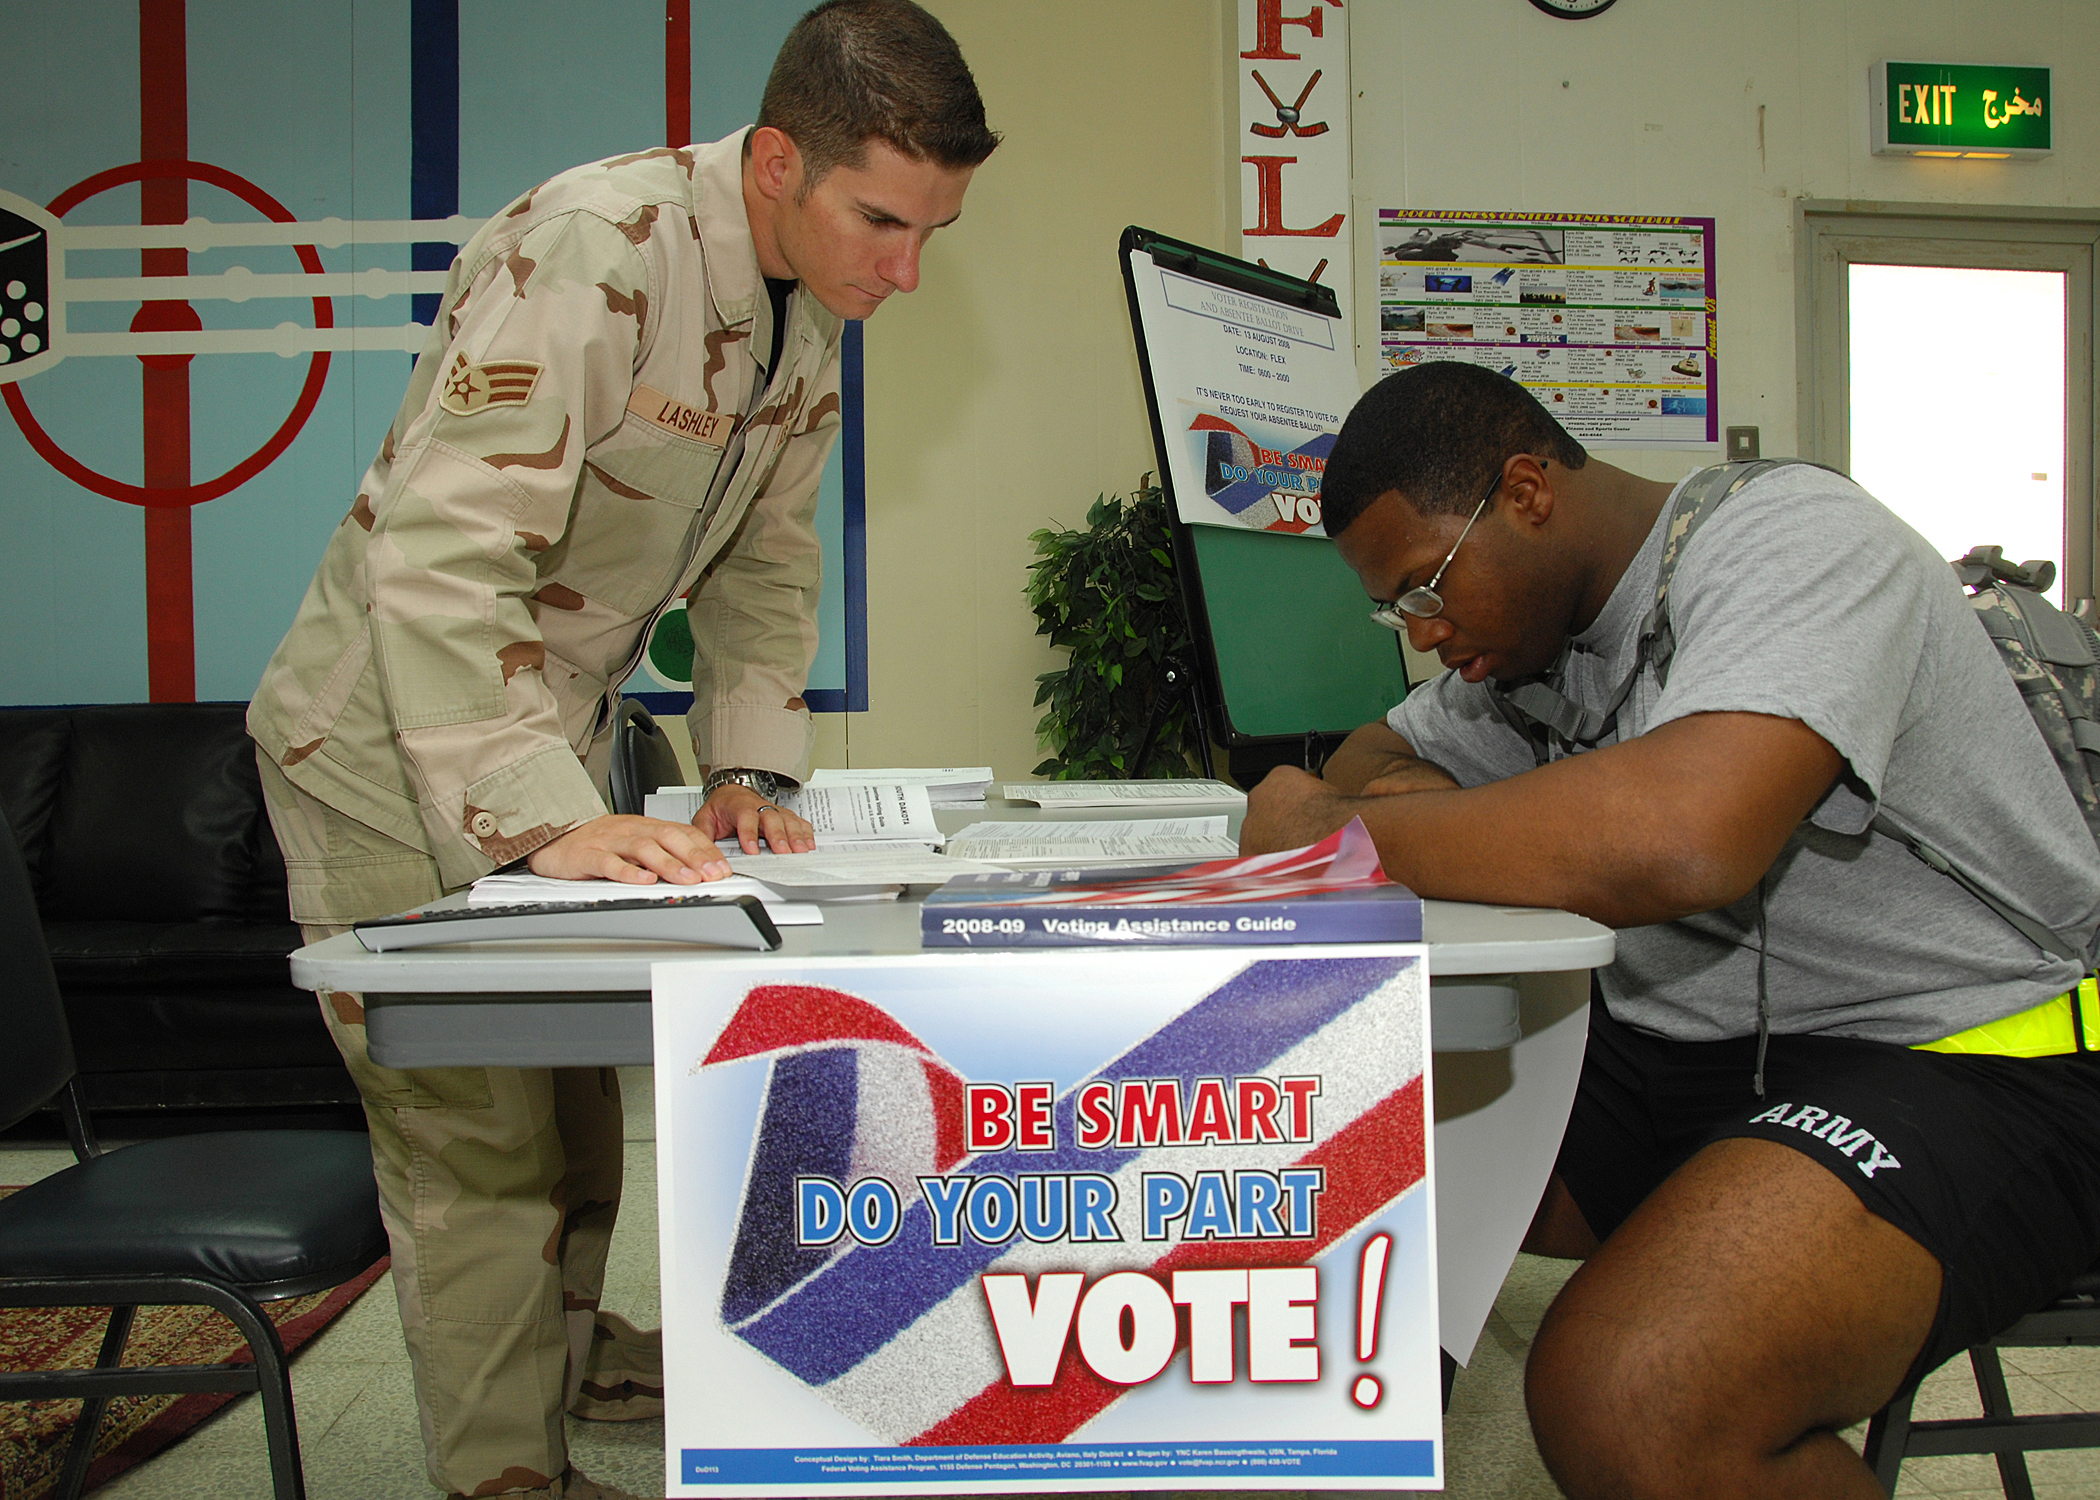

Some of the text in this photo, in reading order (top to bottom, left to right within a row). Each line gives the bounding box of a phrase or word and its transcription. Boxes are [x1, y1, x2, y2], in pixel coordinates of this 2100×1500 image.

[1899, 84, 1957, 125] EXIT
[1982, 87, 2043, 129] مخرج
[1397, 209, 1682, 225] ROCK FITNESS CENTER EVENTS SCHEDULE
[1200, 301, 1304, 337] AND ABSENTEE BALLOT DRIVE
[1211, 291, 1289, 320] VOTER REGISTRATION
[1223, 324, 1242, 337] DATE:
[1244, 330, 1252, 340] 13
[1252, 333, 1277, 345] AUGUST
[1705, 318, 1717, 360] August
[1235, 345, 1286, 365] LOCATION: FLEX
[1238, 363, 1255, 375] TIME:
[656, 401, 720, 438] LASHLEY
[1196, 386, 1340, 424] IT'S NEVER TOO EARLY TO REGISTER TO VOTE OR
[1219, 404, 1325, 433] REQUEST YOUR ABSENTEE BALLOT!
[1261, 448, 1329, 473] BE SMA
[1220, 462, 1248, 482] DO
[1253, 466, 1305, 491] YOUR
[1270, 492, 1322, 525] VO
[898, 801, 910, 825] DAKOTA
[942, 916, 1297, 936] 2008-09 Voting Assistance Guide
[964, 1074, 1322, 1152] BE SMART
[1749, 1103, 1902, 1179] ARMY
[796, 1166, 1325, 1247] DO YOUR PART
[794, 1455, 833, 1463] Conceptual
[834, 1454, 858, 1463] Design
[858, 1454, 870, 1463] by:
[891, 1454, 914, 1462] Smith,
[914, 1453, 954, 1462] Department
[1028, 1452, 1055, 1460] Activity,
[1082, 1451, 1097, 1460] Italy
[1136, 1450, 1160, 1459] Slogan
[1161, 1450, 1172, 1459] by:
[1287, 1448, 1312, 1457] Tampa,
[848, 1465, 870, 1474] Voting
[907, 1464, 938, 1473] Program,
[984, 1463, 1018, 1471] Pentagon,
[1018, 1462, 1060, 1471] Washington,
